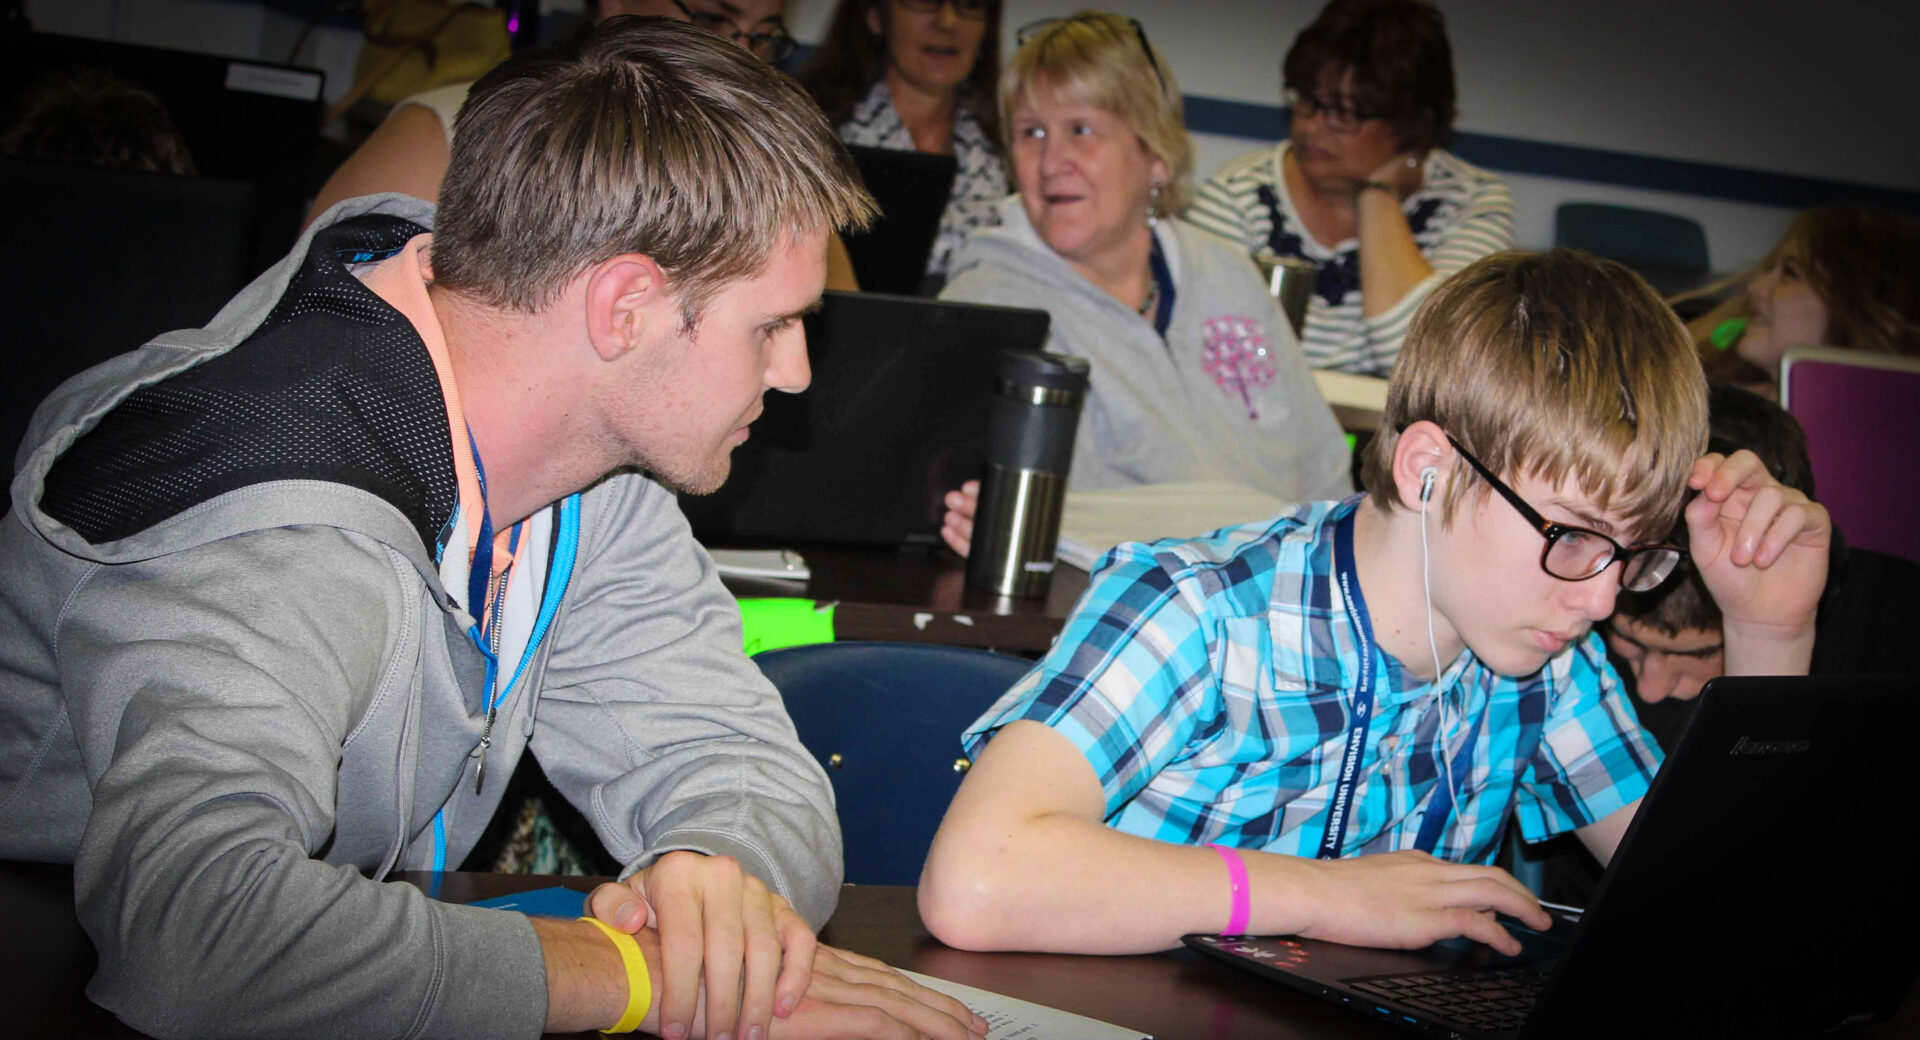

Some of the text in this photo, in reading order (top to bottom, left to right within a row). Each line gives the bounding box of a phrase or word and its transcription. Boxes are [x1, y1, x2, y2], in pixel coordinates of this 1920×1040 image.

[1340, 571, 1370, 693] www.envisionuniversity.org
[1325, 727, 1364, 850] ENVISION UNIVERSITY
